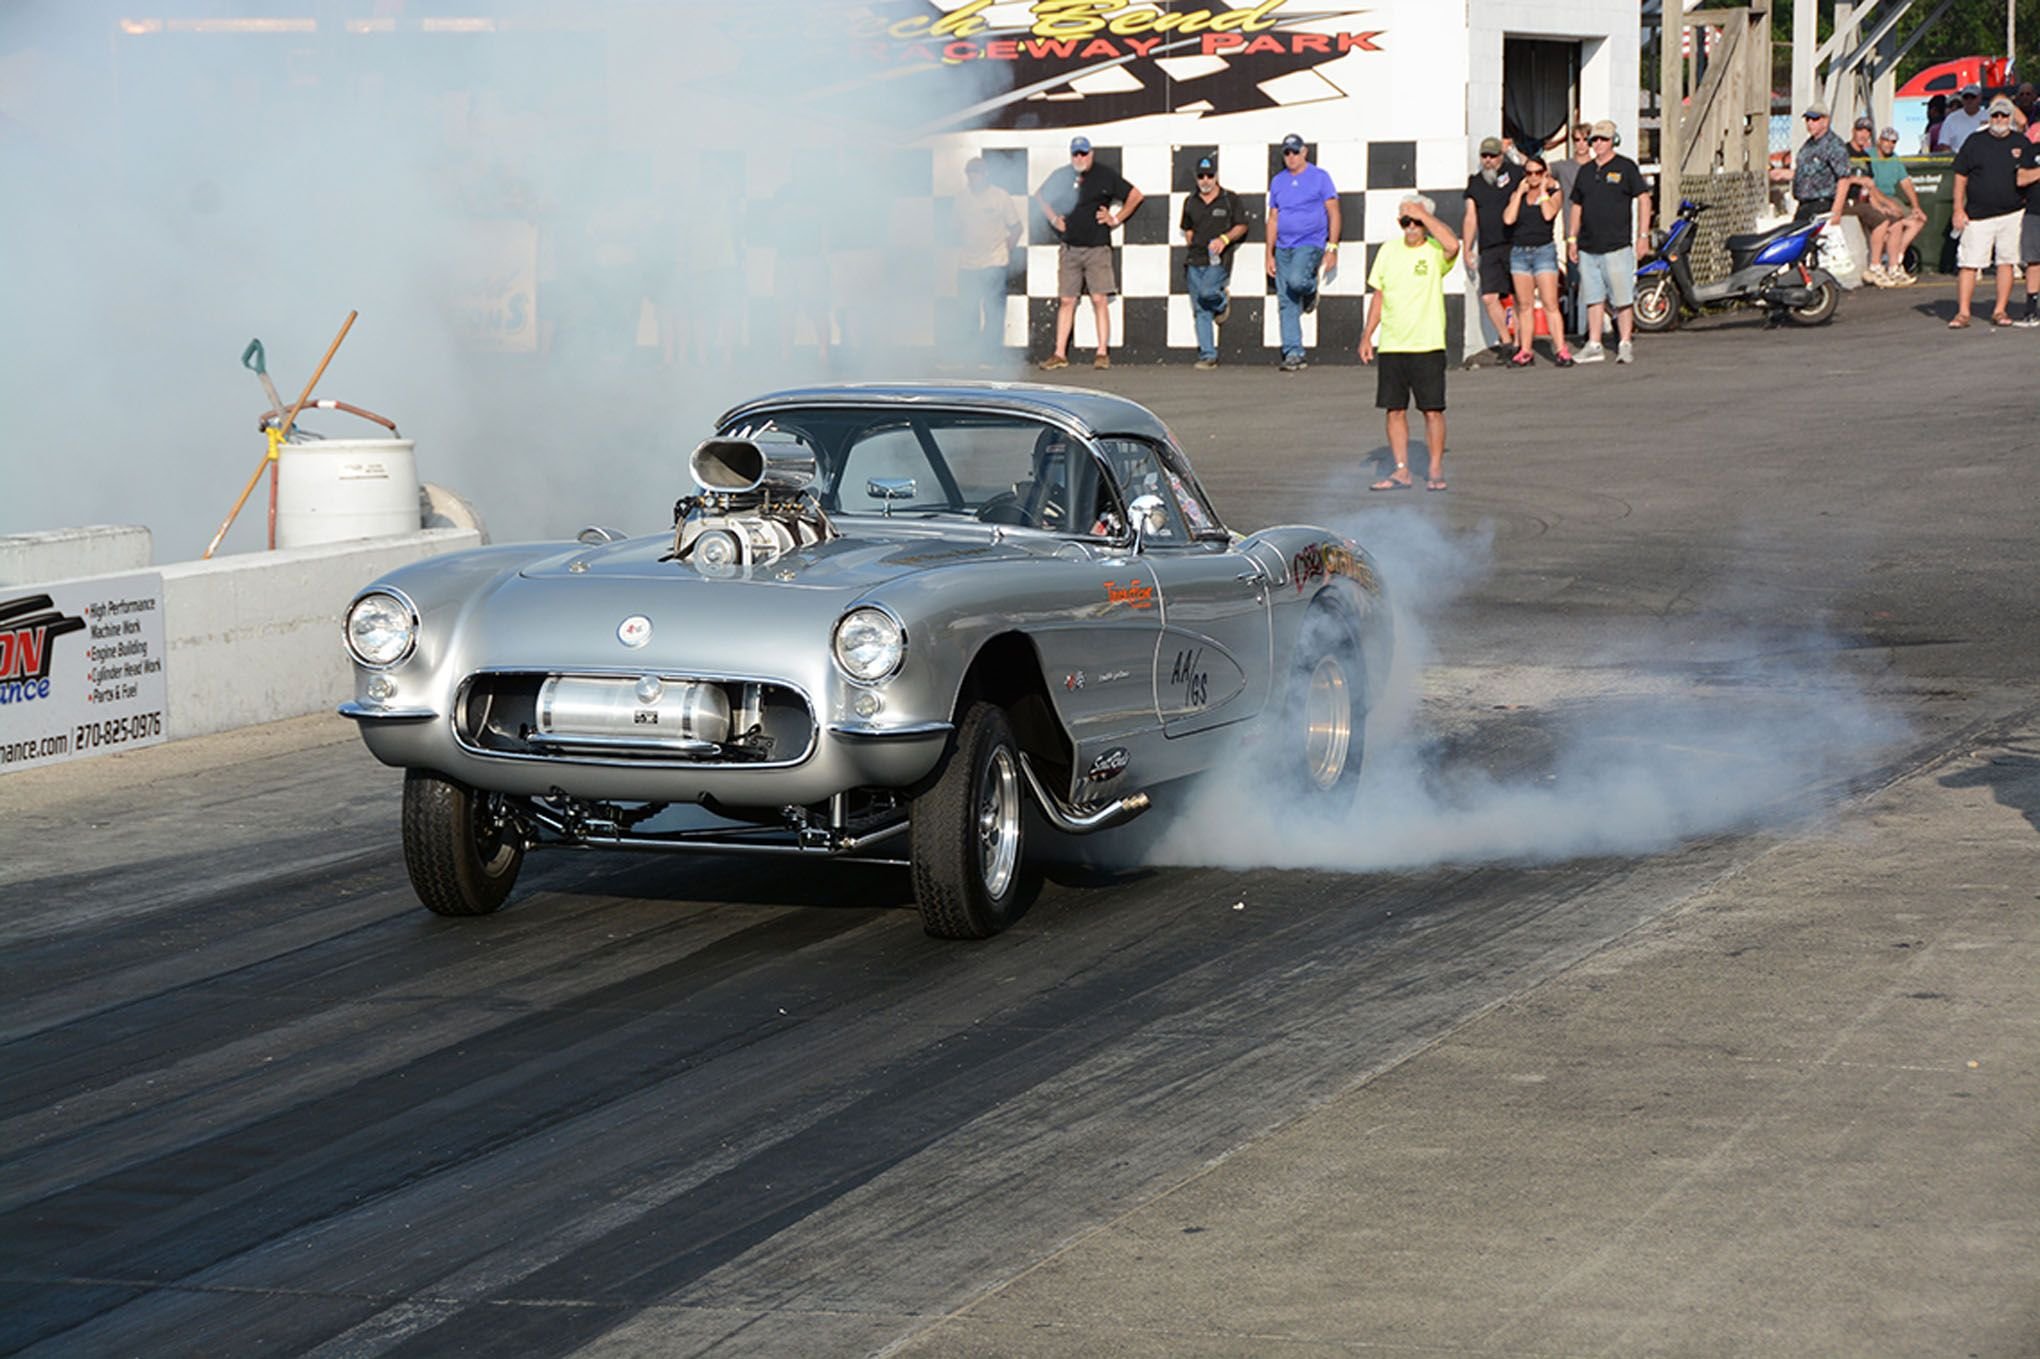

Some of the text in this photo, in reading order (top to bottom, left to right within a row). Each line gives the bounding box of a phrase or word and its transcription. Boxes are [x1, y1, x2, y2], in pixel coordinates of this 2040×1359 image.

[1201, 31, 1386, 55] PARK
[108, 599, 155, 616] Performance
[92, 639, 148, 664] Engine Building
[92, 665, 122, 686] Cylinder
[93, 688, 114, 704] Parts
[76, 711, 161, 750] 270-825-0976
